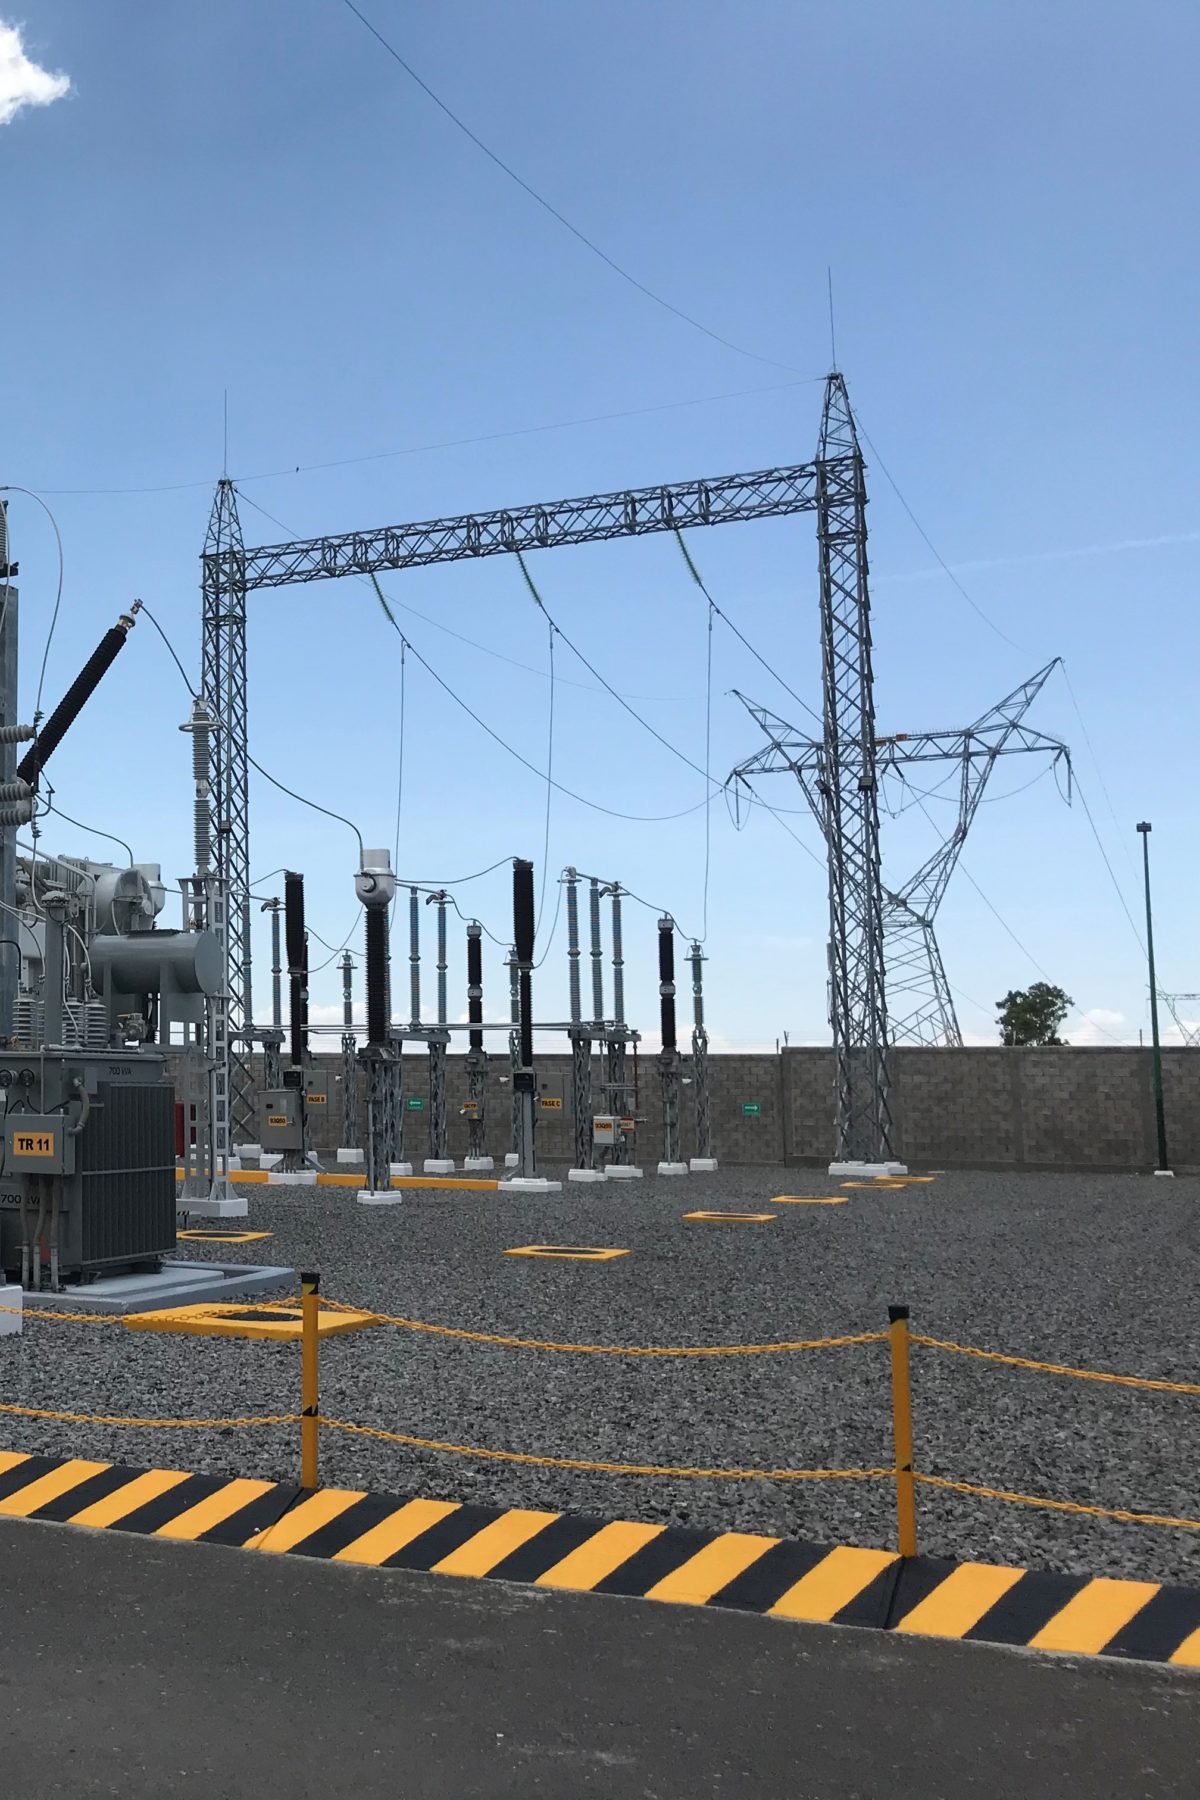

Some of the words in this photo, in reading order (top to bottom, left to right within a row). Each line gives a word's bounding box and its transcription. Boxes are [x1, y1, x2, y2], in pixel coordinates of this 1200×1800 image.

[109, 1066, 120, 1075] 700
[18, 1138, 34, 1150] TR
[37, 1138, 49, 1151] 11
[1, 1194, 22, 1204] 700
